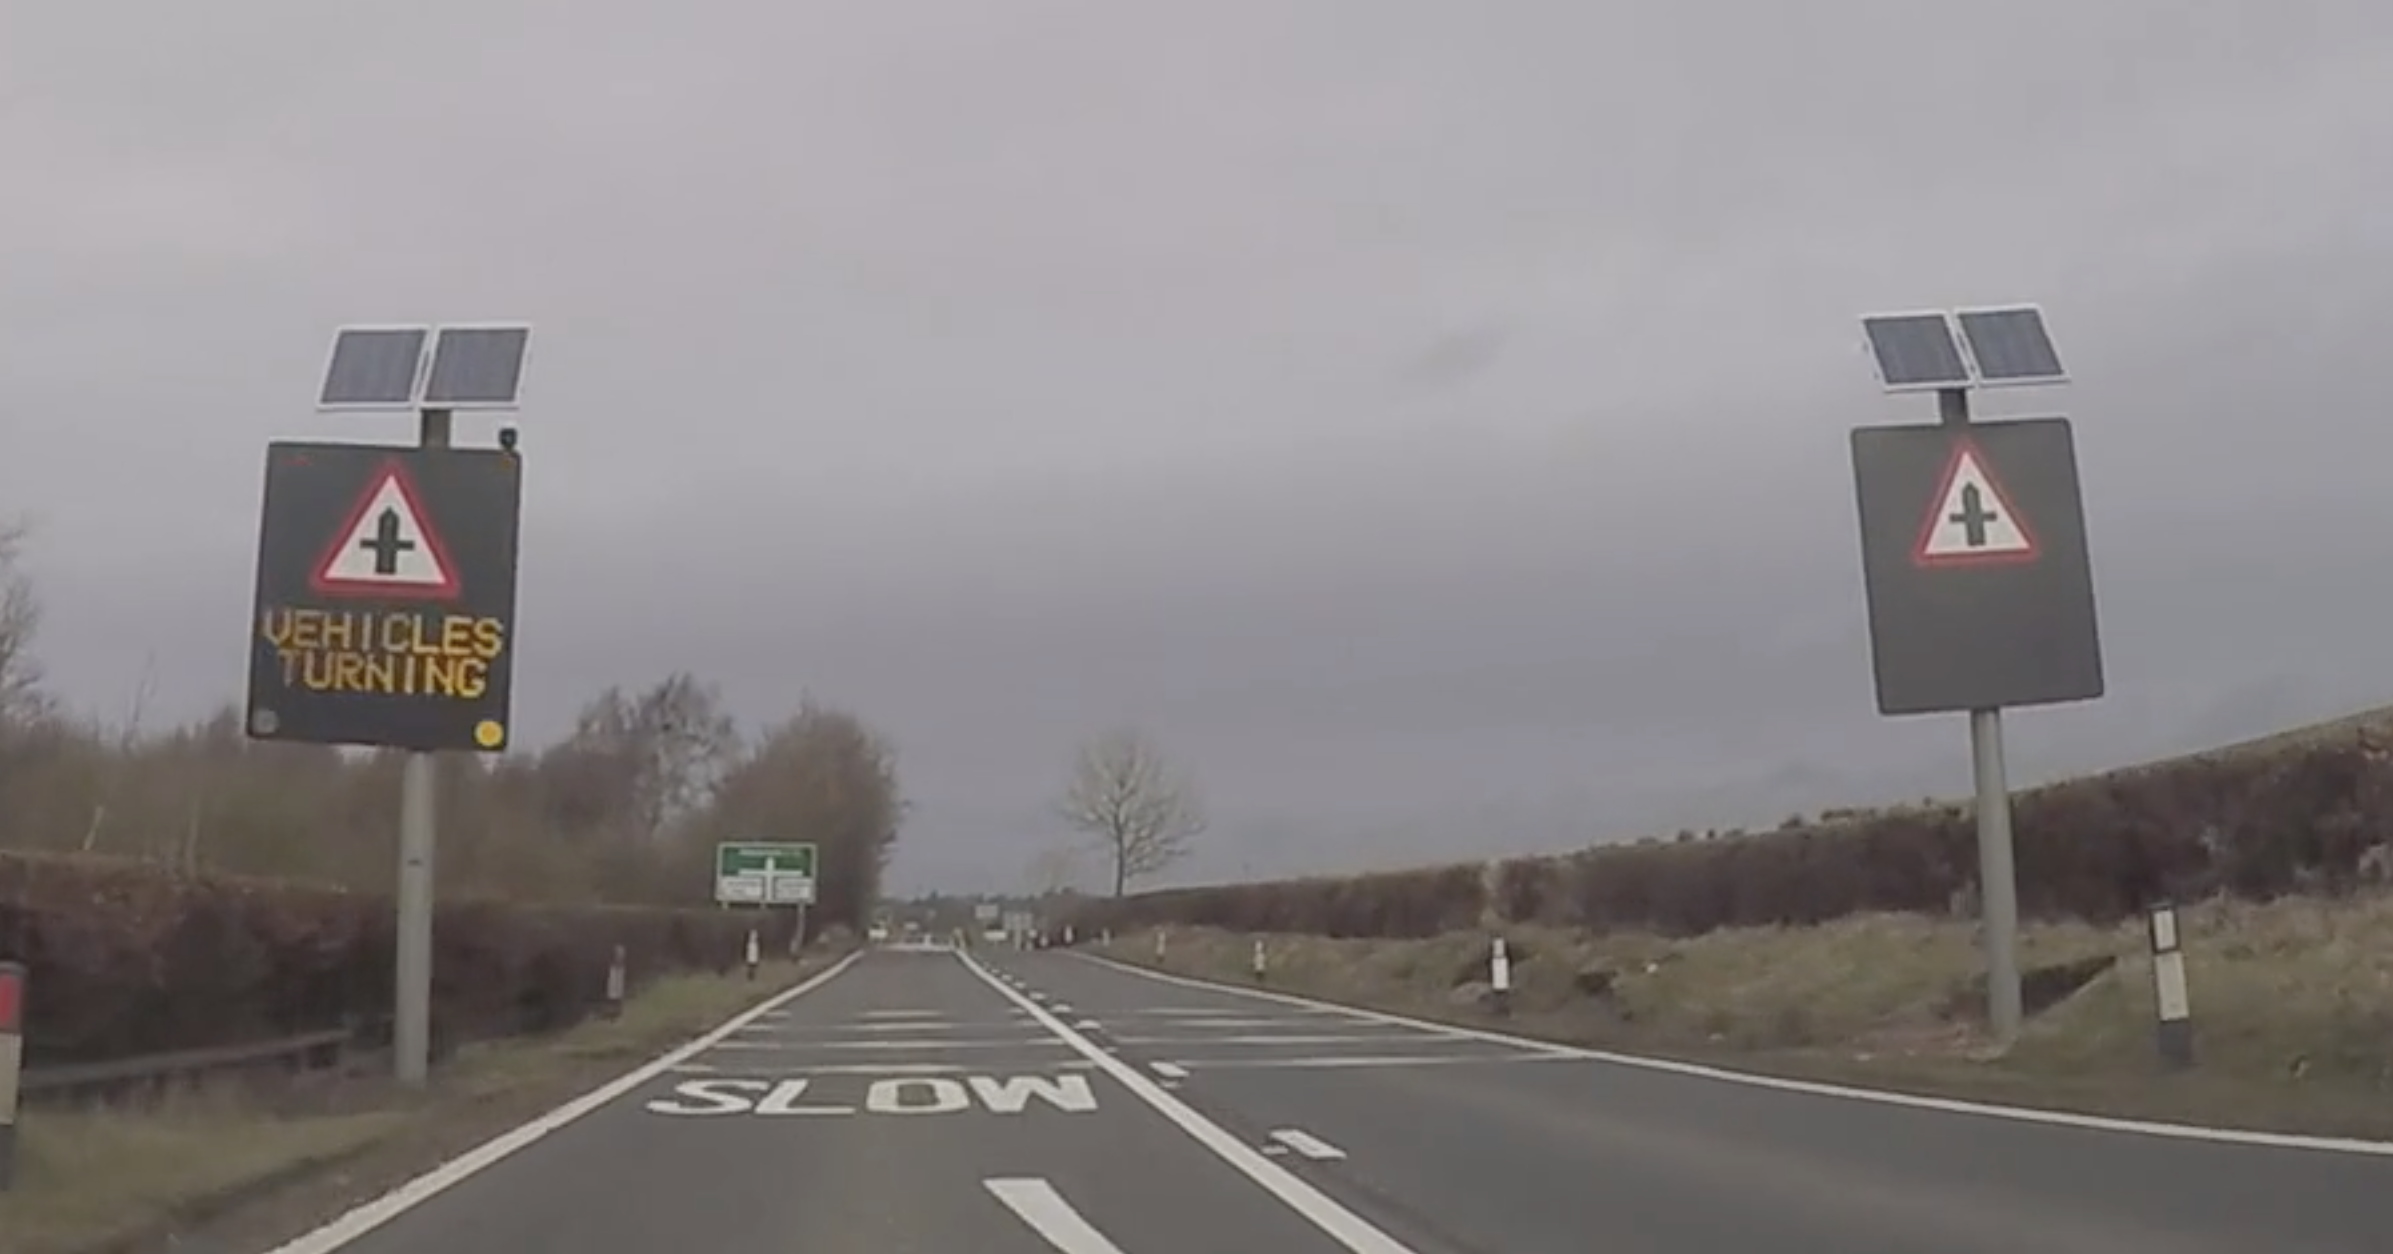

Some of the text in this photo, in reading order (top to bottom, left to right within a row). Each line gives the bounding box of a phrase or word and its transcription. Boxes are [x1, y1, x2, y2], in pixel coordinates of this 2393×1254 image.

[264, 609, 504, 657] VEHICLES
[279, 650, 488, 697] TURNING
[646, 1075, 1098, 1115] SLOW
